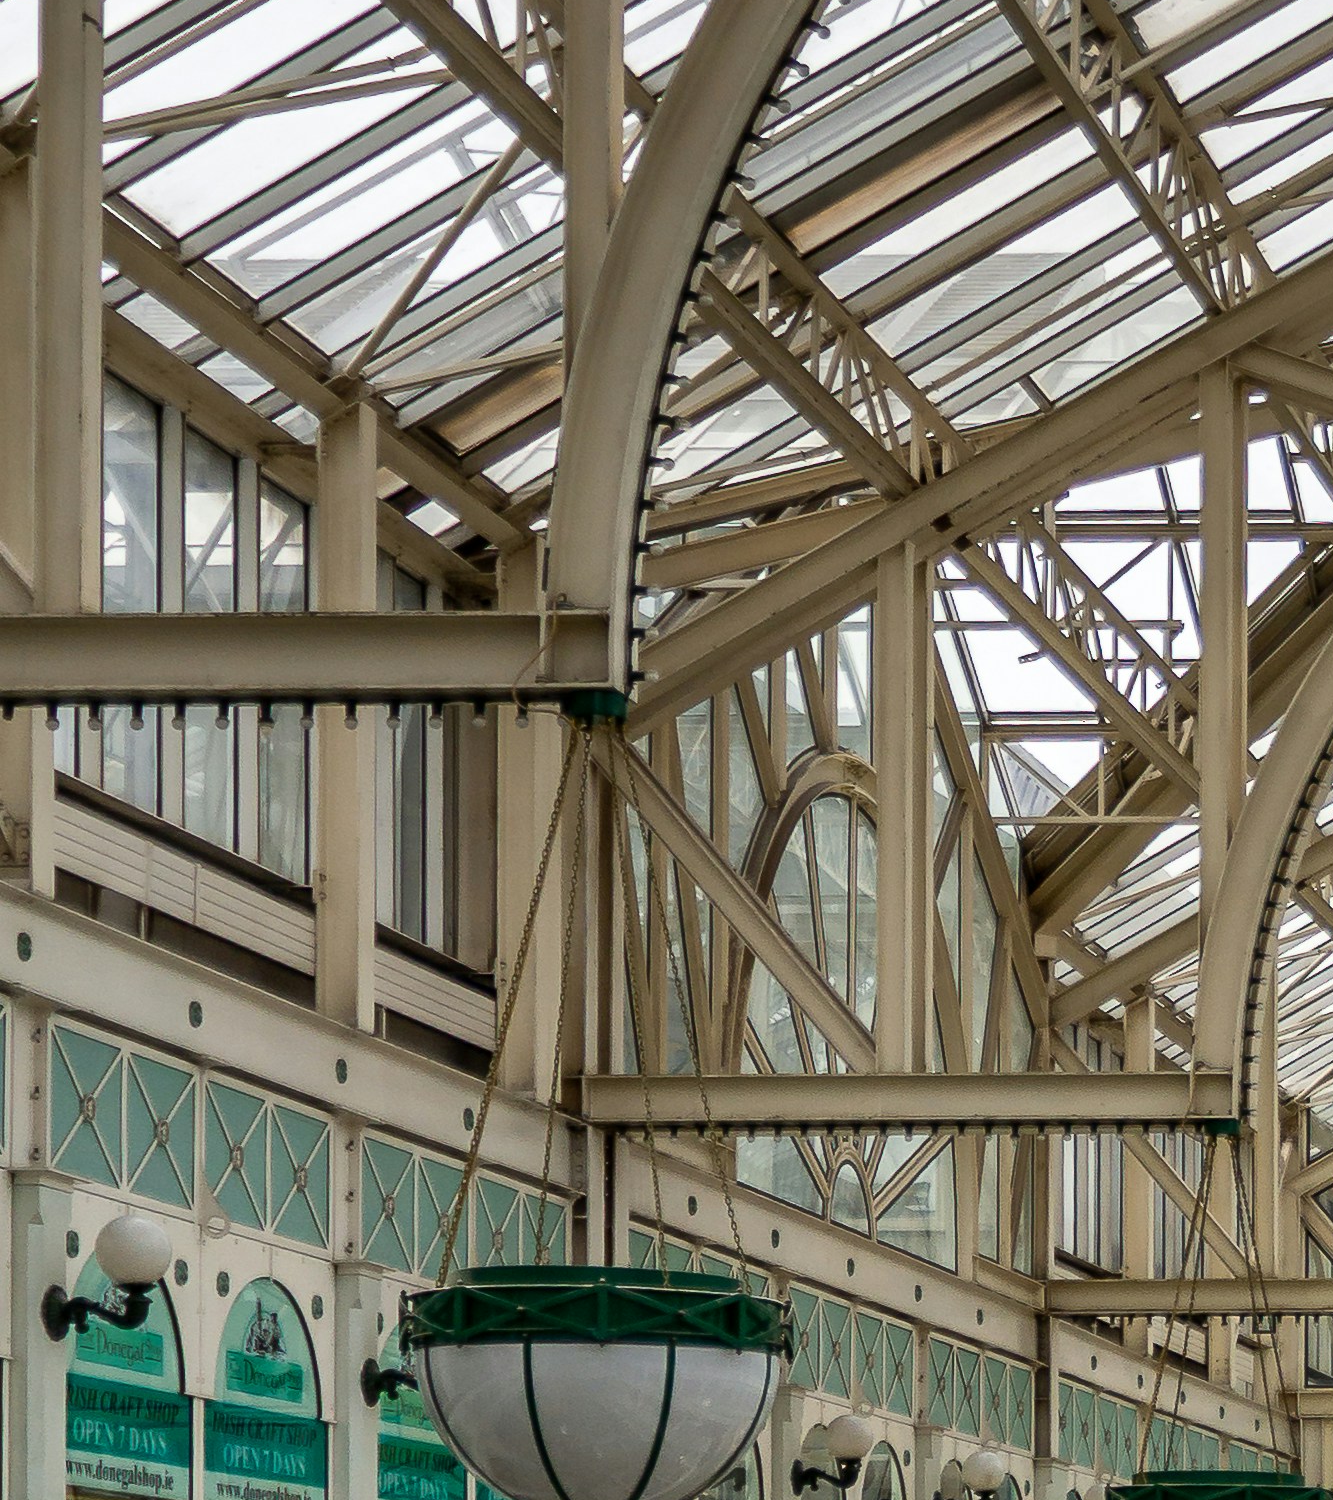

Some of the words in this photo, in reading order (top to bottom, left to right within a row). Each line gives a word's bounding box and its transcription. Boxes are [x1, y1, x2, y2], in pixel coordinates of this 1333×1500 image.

[100, 1389, 142, 1419] CRAFT
[145, 1398, 180, 1426] SHOP
[73, 1417, 114, 1446] OPEN
[117, 1425, 126, 1449] 7
[129, 1427, 168, 1456] DAYS
[213, 1411, 245, 1438] IRISH
[249, 1417, 286, 1444] CRAFT
[287, 1424, 318, 1449] SHOP
[66, 1458, 174, 1495] www.donegalshop.ie
[223, 1443, 260, 1470] OPEN
[262, 1450, 270, 1472] 7
[273, 1451, 306, 1478] DAYS
[419, 1477, 449, 1500] DAYS
